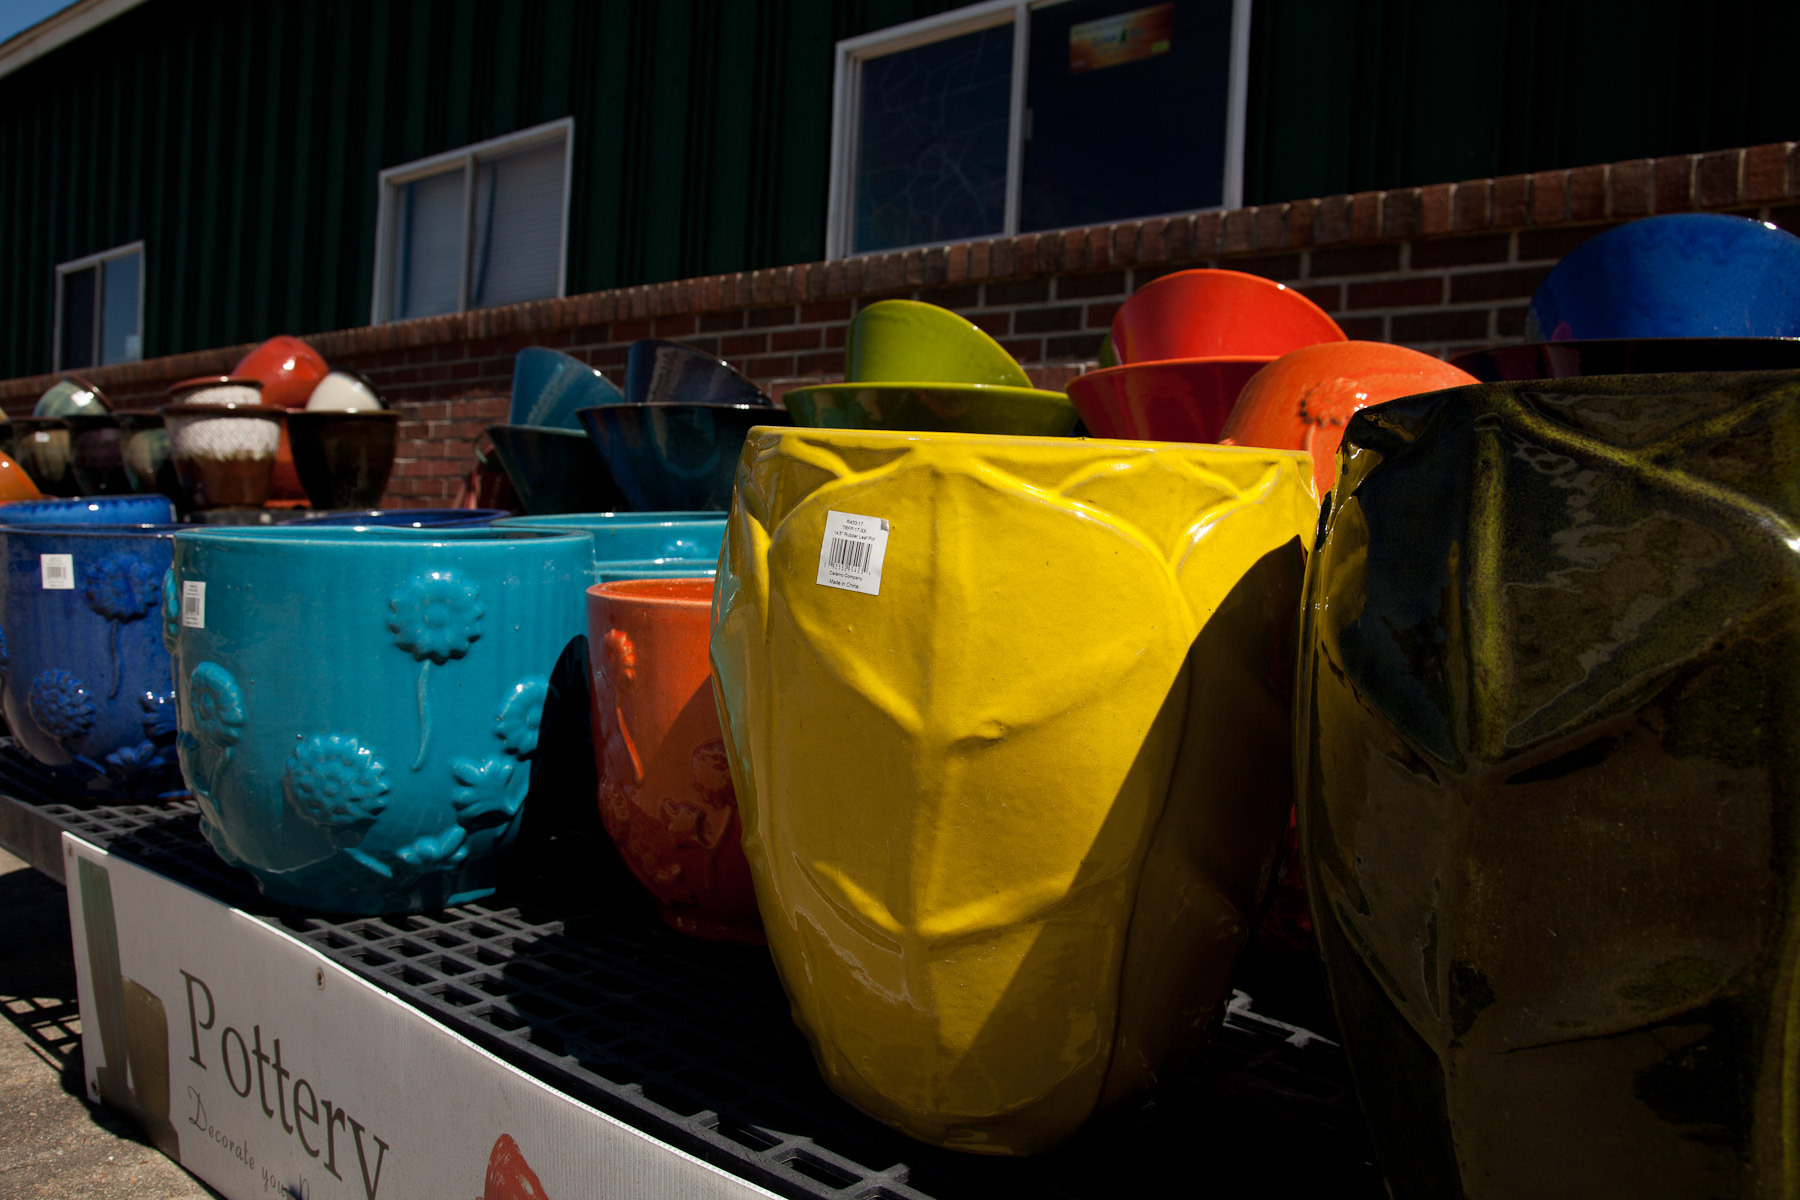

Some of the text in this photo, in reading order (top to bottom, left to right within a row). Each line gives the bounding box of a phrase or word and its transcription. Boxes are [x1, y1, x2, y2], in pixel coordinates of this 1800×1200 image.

[844, 531, 858, 539] Rubber
[829, 570, 863, 581] Ceramic Company
[829, 578, 841, 586] Made
[846, 581, 859, 589] China
[179, 968, 389, 1200] Pottery
[187, 1085, 255, 1170] Decorate
[262, 1166, 290, 1198] you
